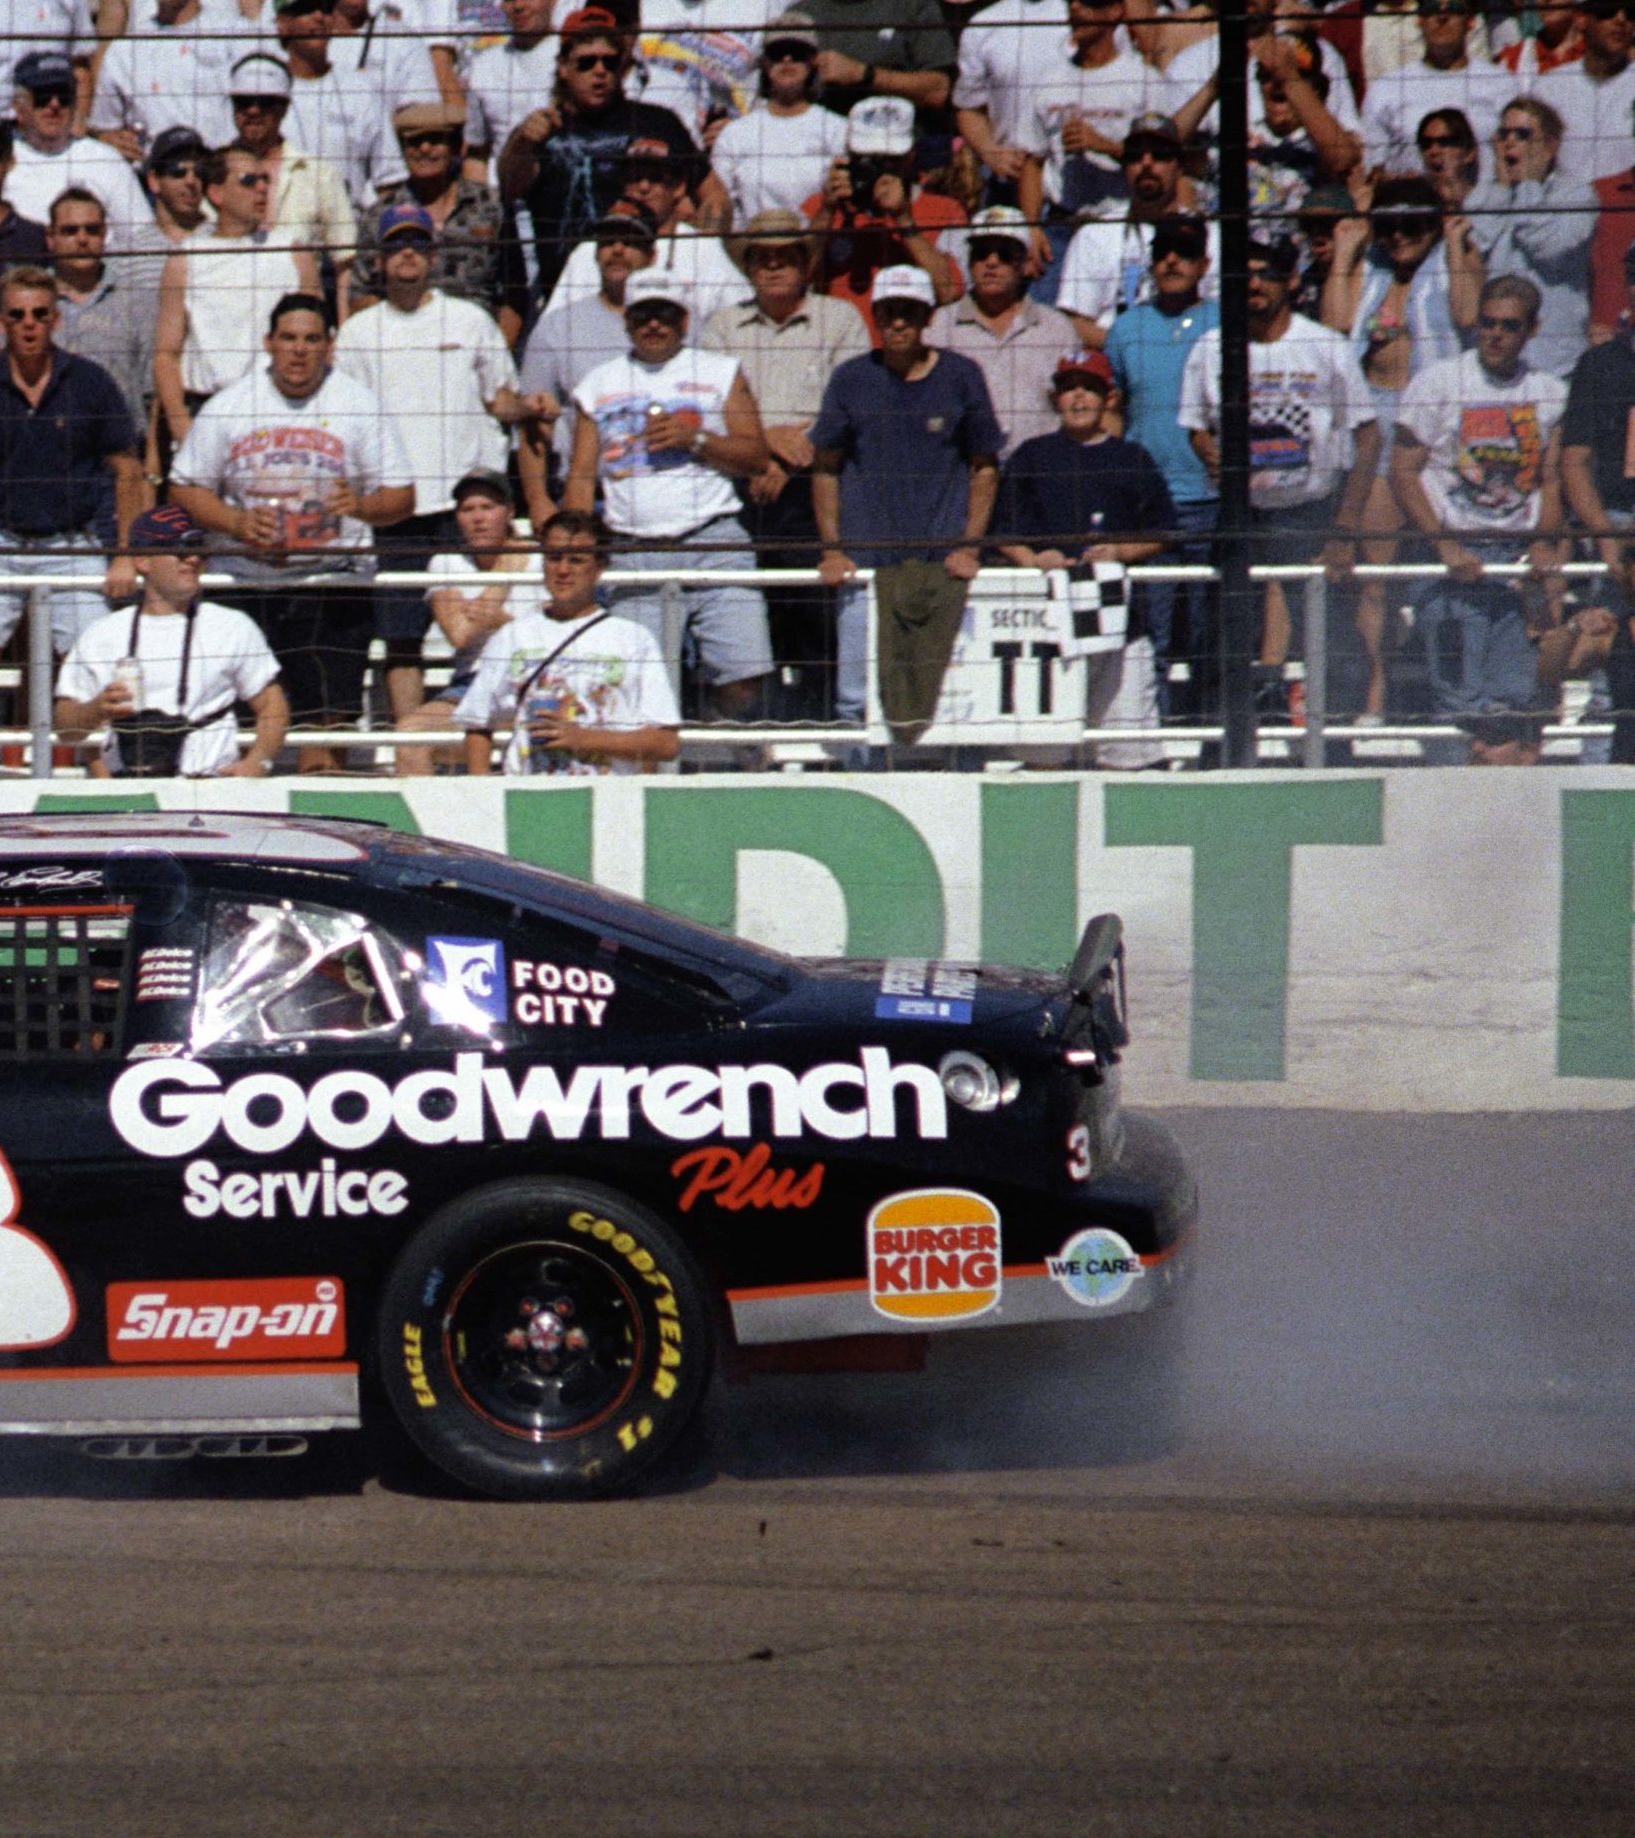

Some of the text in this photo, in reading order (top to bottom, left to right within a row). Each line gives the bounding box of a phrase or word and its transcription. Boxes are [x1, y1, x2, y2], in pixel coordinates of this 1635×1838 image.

[512, 960, 615, 996] FOOD
[517, 993, 607, 1026] CITY
[109, 1047, 947, 1157] Goodwrench
[672, 1142, 826, 1213] Plus
[1067, 1125, 1091, 1183] 3
[183, 1158, 408, 1219] Service
[872, 1224, 998, 1256] BURGER
[1051, 1260, 1082, 1275] WE
[872, 1252, 998, 1293] KING
[117, 1294, 338, 1349] Snap-on
[403, 1322, 437, 1407] EAGLE
